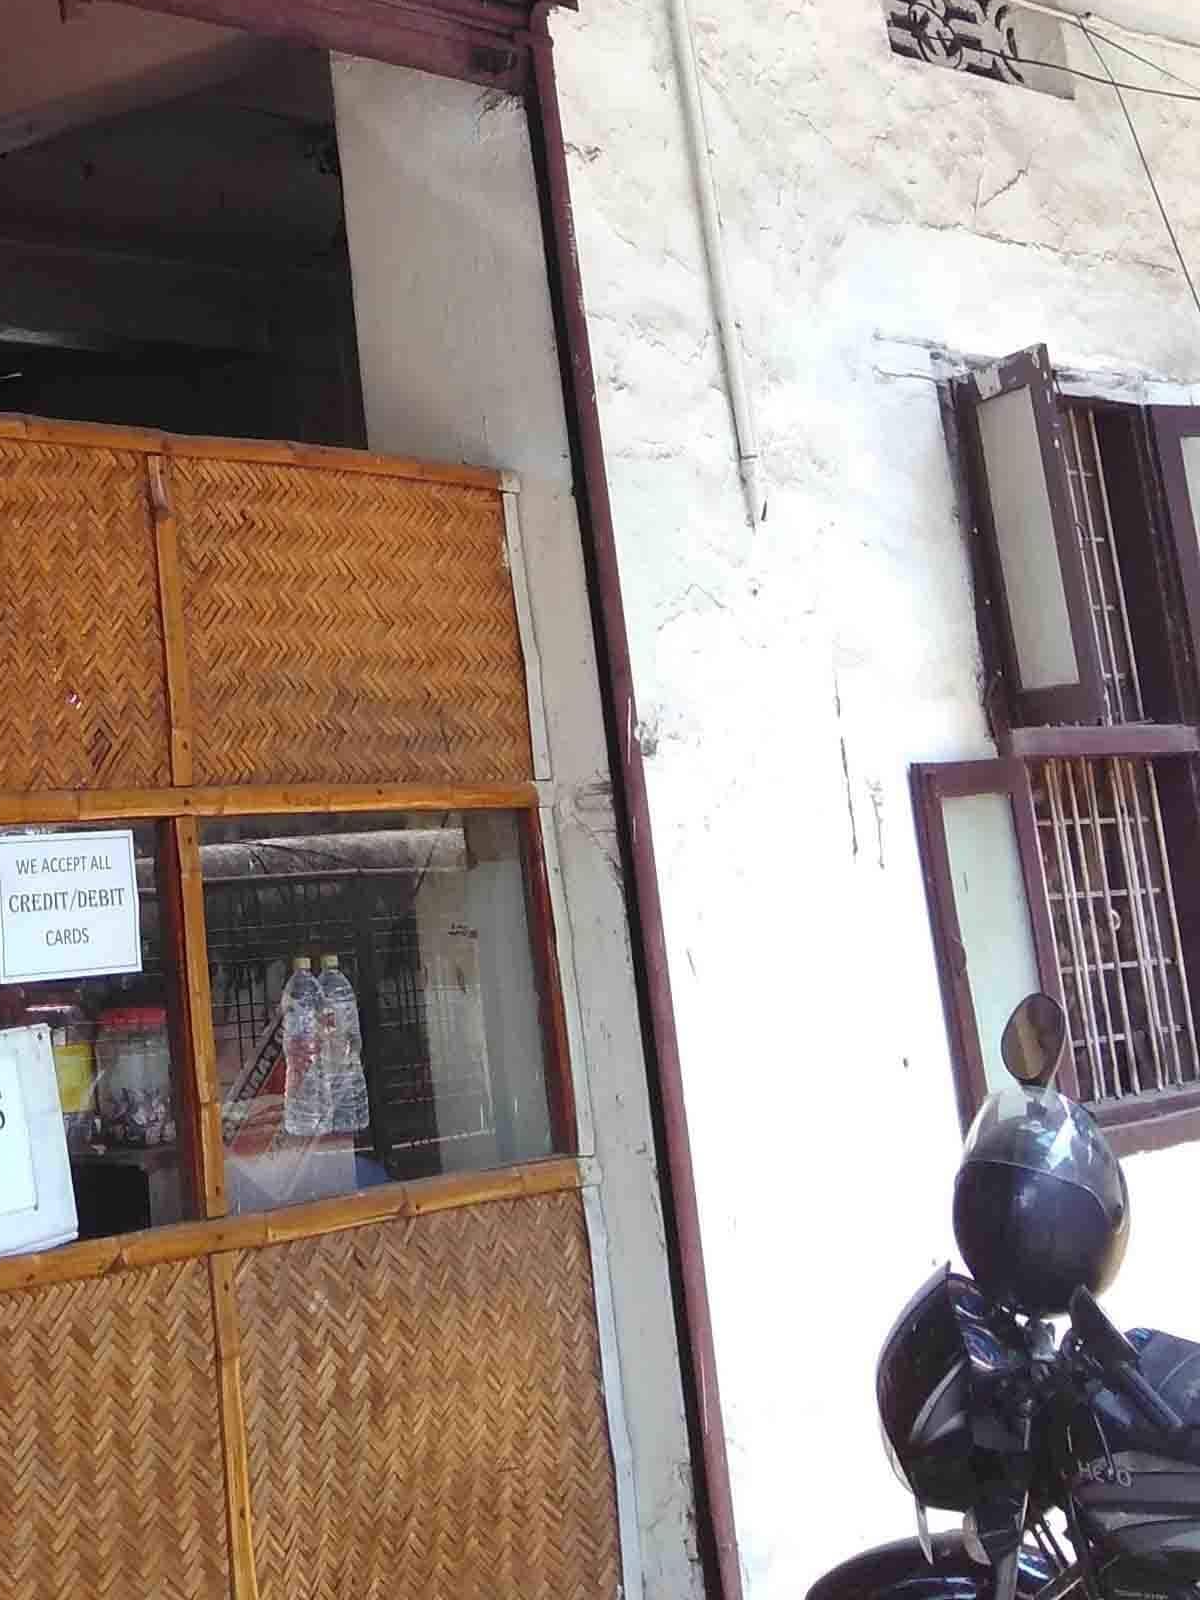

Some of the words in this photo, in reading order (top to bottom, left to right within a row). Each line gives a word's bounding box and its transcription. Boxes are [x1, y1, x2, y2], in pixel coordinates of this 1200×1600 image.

[15, 858, 39, 875] WE
[41, 856, 87, 873] ACCEPT
[90, 855, 112, 871] ALL
[8, 888, 125, 913] CREDIT/DEBIT
[45, 928, 90, 947] CARDS
